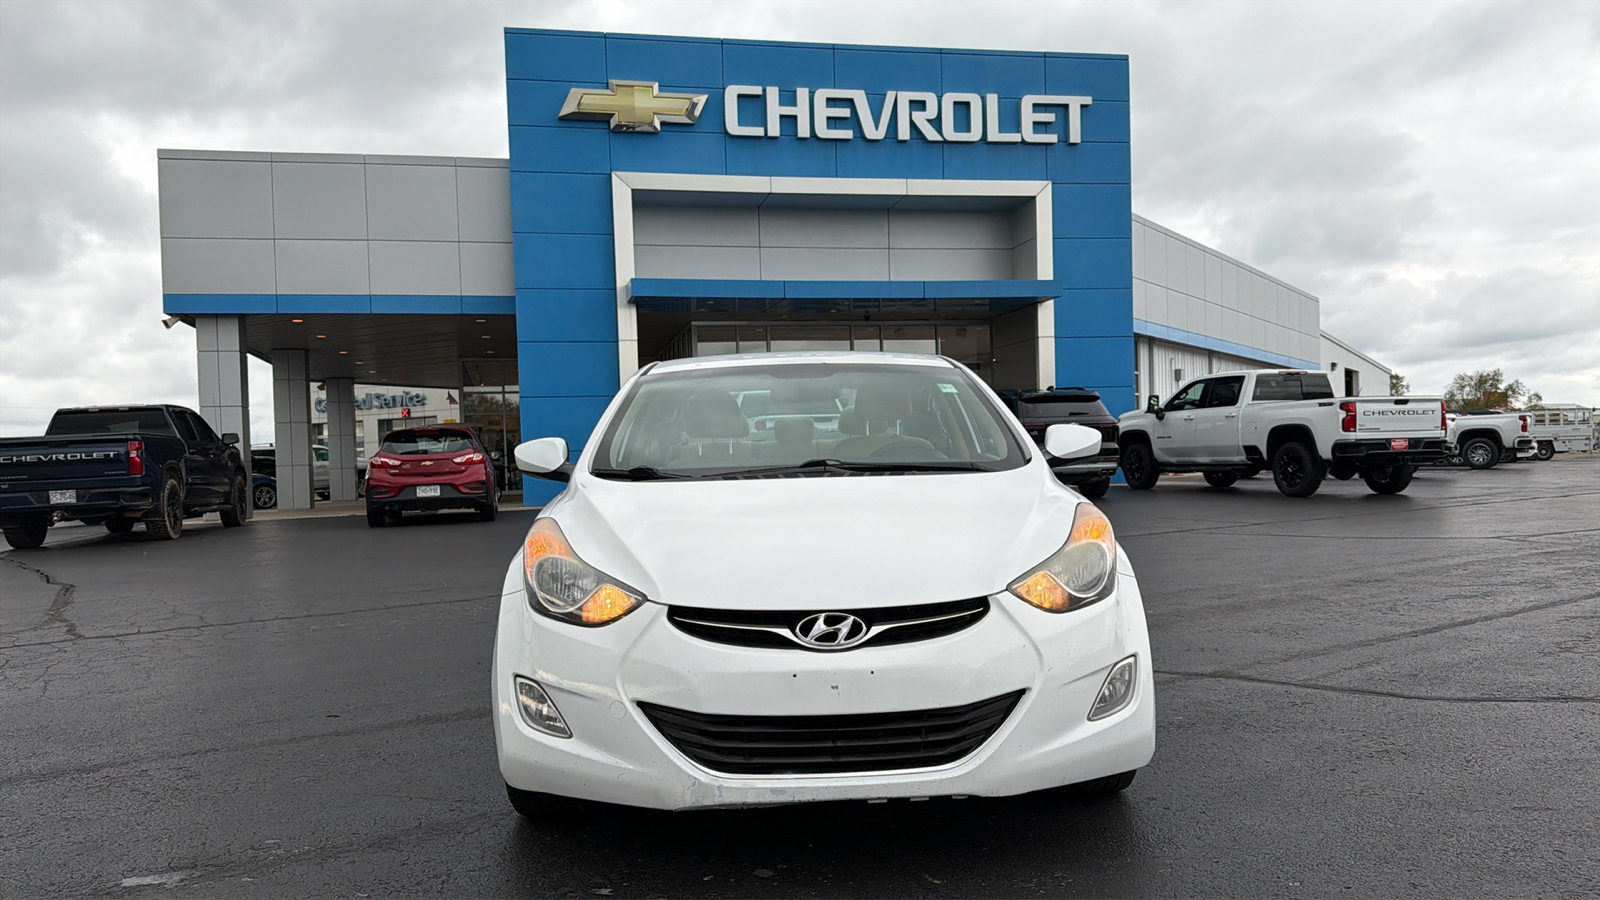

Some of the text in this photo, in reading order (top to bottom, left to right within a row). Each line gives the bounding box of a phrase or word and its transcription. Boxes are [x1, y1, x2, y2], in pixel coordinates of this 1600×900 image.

[724, 84, 1093, 144] CHEVROLET
[372, 391, 425, 409] Service
[0, 452, 118, 463] CHEVROLET
